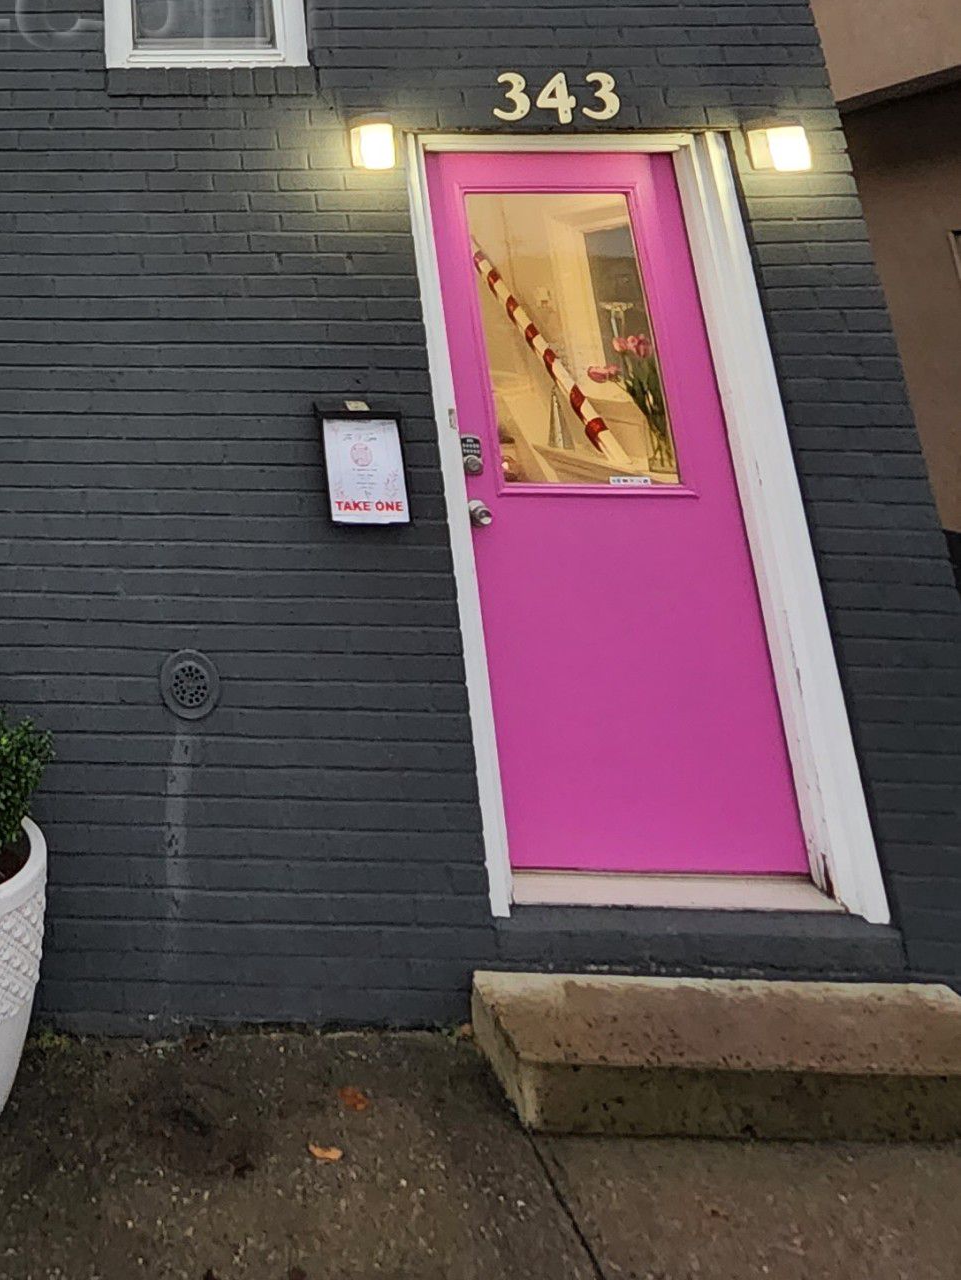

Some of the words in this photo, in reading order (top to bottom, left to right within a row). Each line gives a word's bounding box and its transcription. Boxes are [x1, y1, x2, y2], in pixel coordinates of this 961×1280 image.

[492, 71, 621, 125] 343
[335, 500, 372, 512] TAKE
[375, 500, 405, 512] ONE
